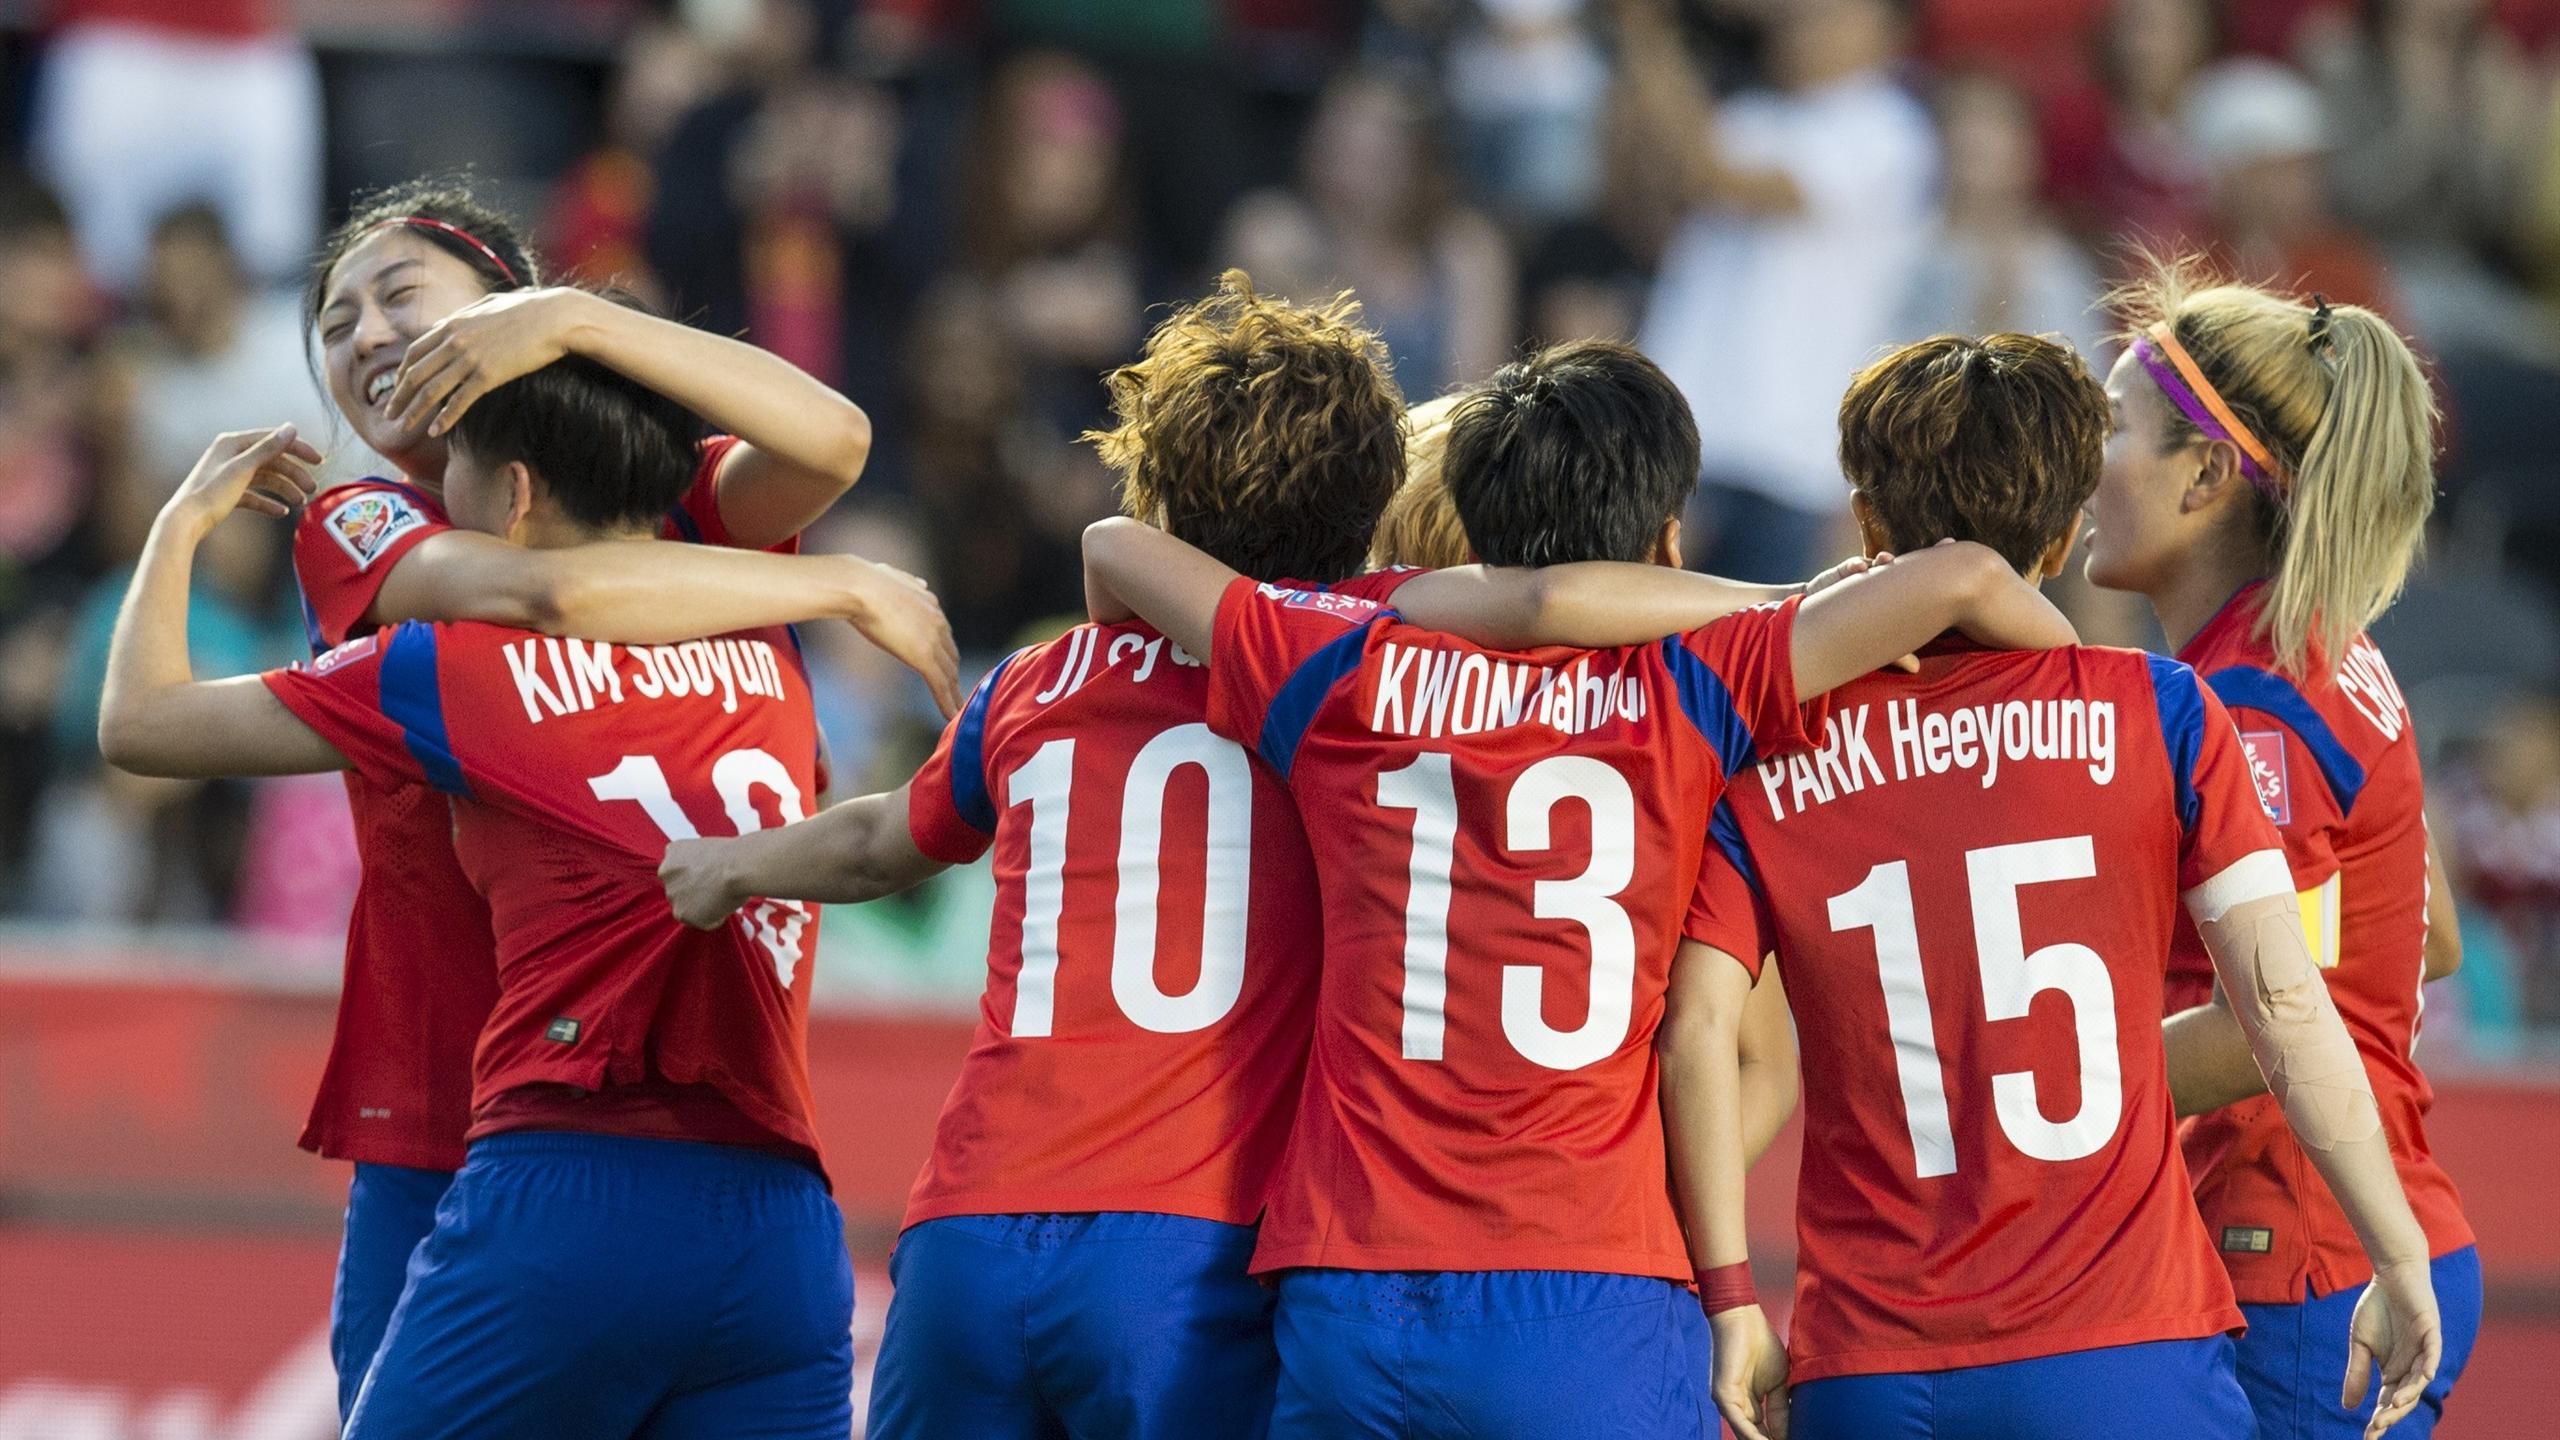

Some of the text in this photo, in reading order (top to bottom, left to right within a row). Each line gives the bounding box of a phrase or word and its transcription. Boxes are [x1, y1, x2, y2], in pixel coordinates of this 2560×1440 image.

[502, 637, 625, 724] KIM
[1371, 642, 1529, 739] KWON
[1757, 703, 1887, 823] PARK
[1888, 697, 2116, 790] Heeyoung
[1008, 722, 1253, 1038] 10
[1376, 751, 1637, 1072] 13
[1826, 834, 2124, 1179] 15
